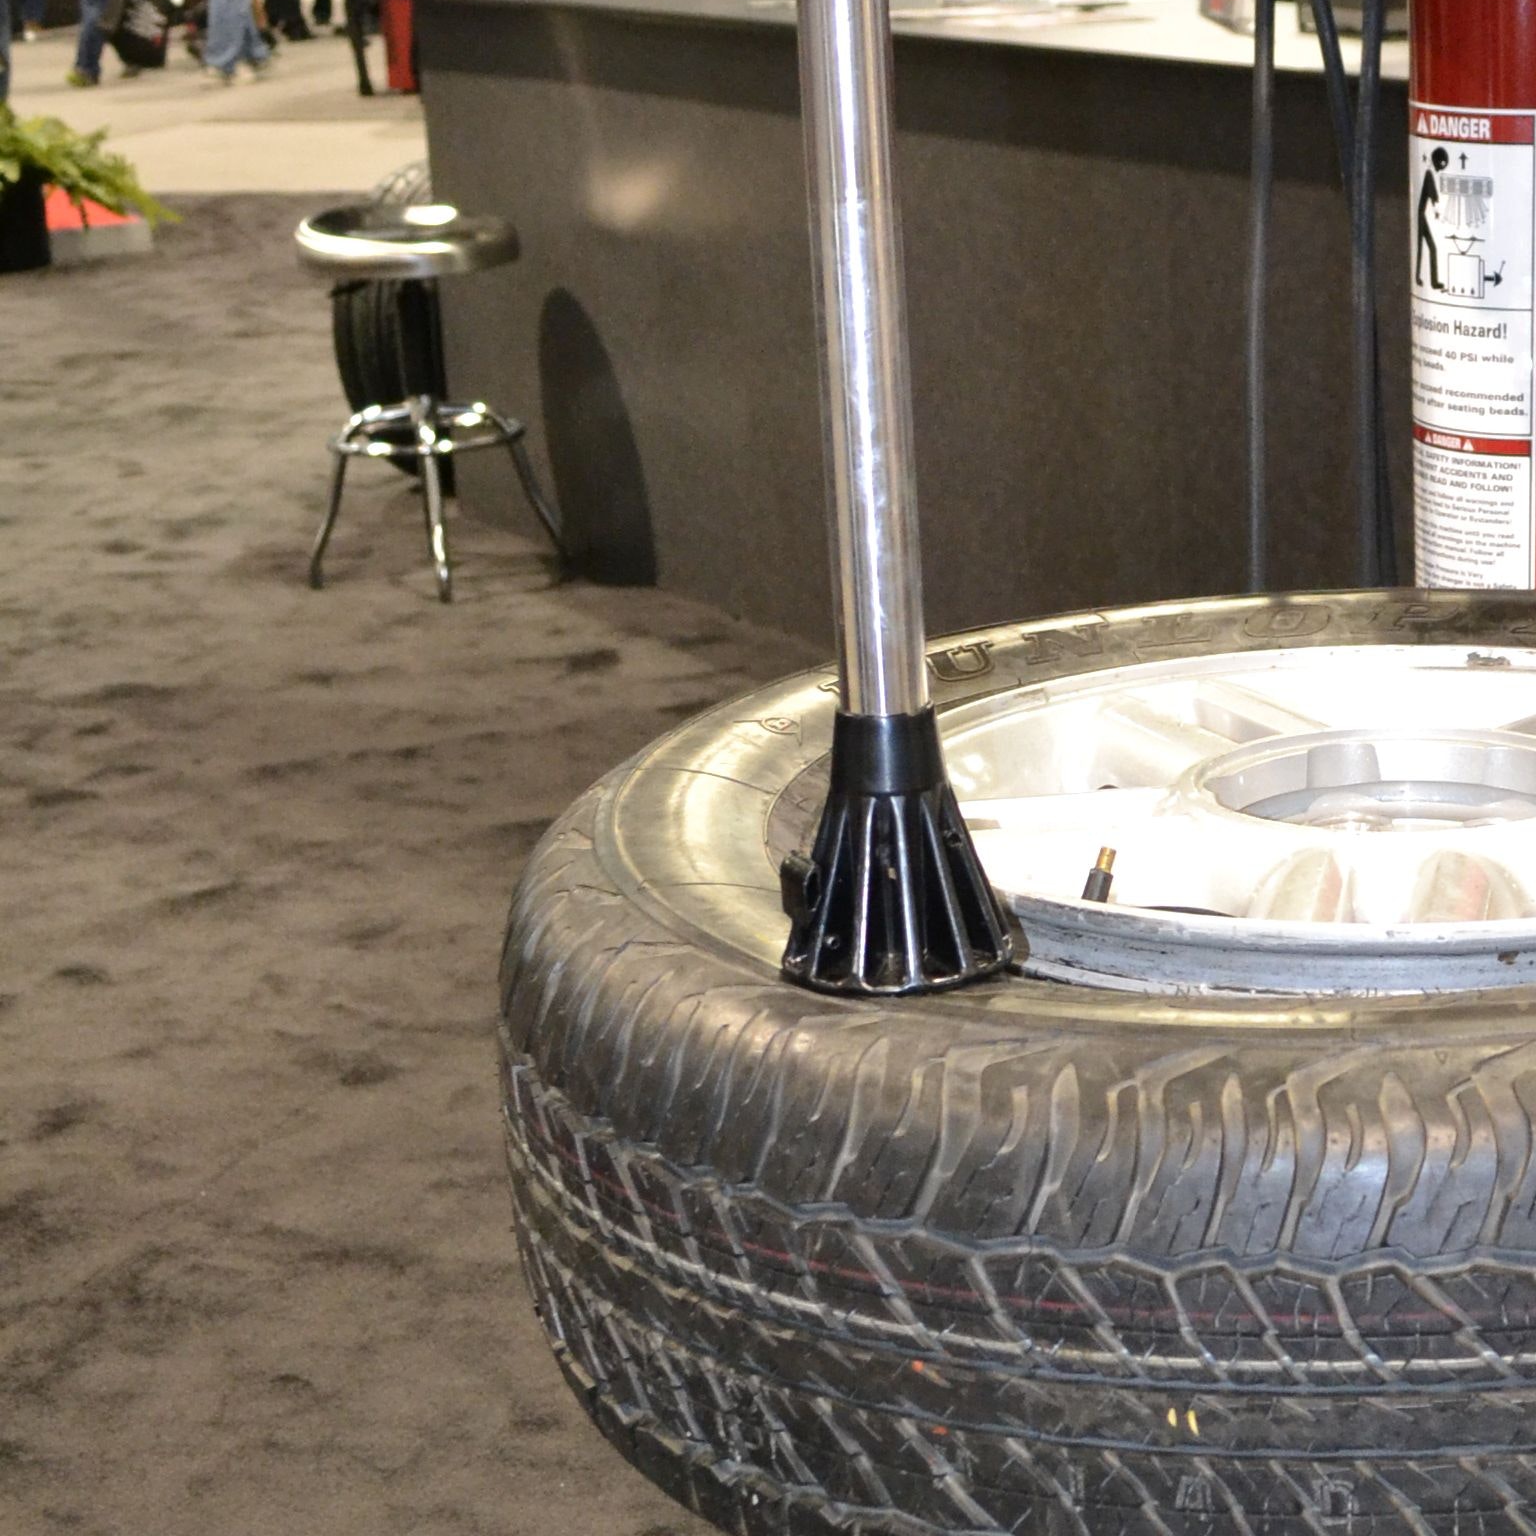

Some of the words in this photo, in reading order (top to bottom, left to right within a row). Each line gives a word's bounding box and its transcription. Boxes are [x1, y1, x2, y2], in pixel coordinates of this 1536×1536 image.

[1430, 117, 1491, 139] DANGER
[1453, 320, 1507, 339] Hazard!
[1445, 351, 1457, 360] 40
[1460, 352, 1478, 362] PSI
[1482, 354, 1515, 364] while
[1445, 389, 1525, 402] recommended
[1448, 403, 1485, 416] seating
[1489, 406, 1528, 416] beads.
[1439, 467, 1487, 479] ACCIDENTS
[1491, 473, 1513, 481] AND
[817, 601, 1462, 696] UNLOP
